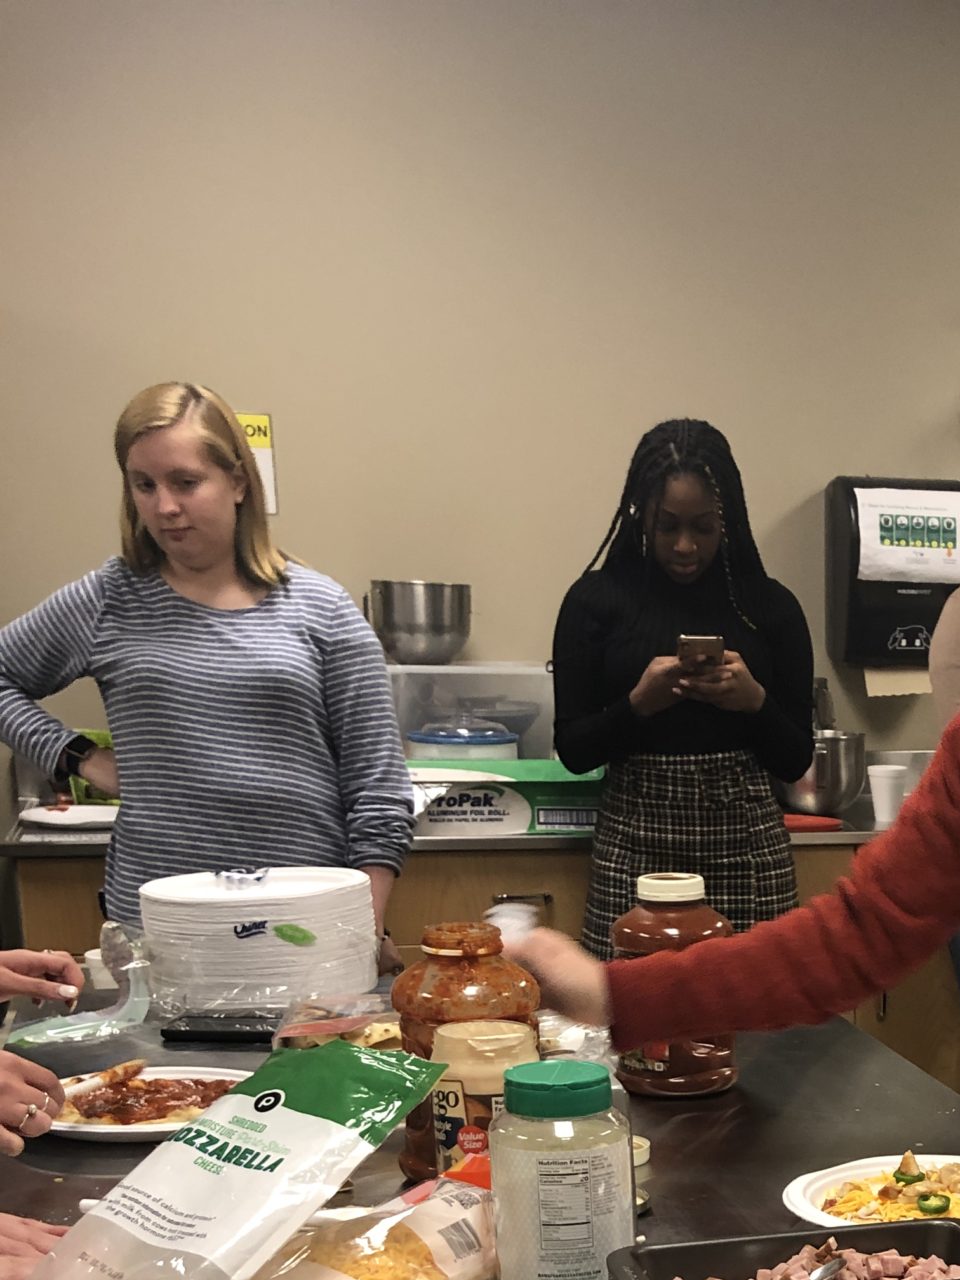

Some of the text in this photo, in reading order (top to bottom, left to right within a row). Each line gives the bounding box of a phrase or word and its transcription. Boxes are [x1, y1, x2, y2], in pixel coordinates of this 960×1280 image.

[430, 792, 495, 808] roPak
[469, 809, 486, 817] FOIL
[458, 1131, 486, 1141] Value
[463, 1140, 483, 1150] Size
[135, 1209, 152, 1223] from
[160, 1202, 185, 1217] calcium
[113, 1209, 139, 1225] growth
[139, 1221, 168, 1240] hormone
